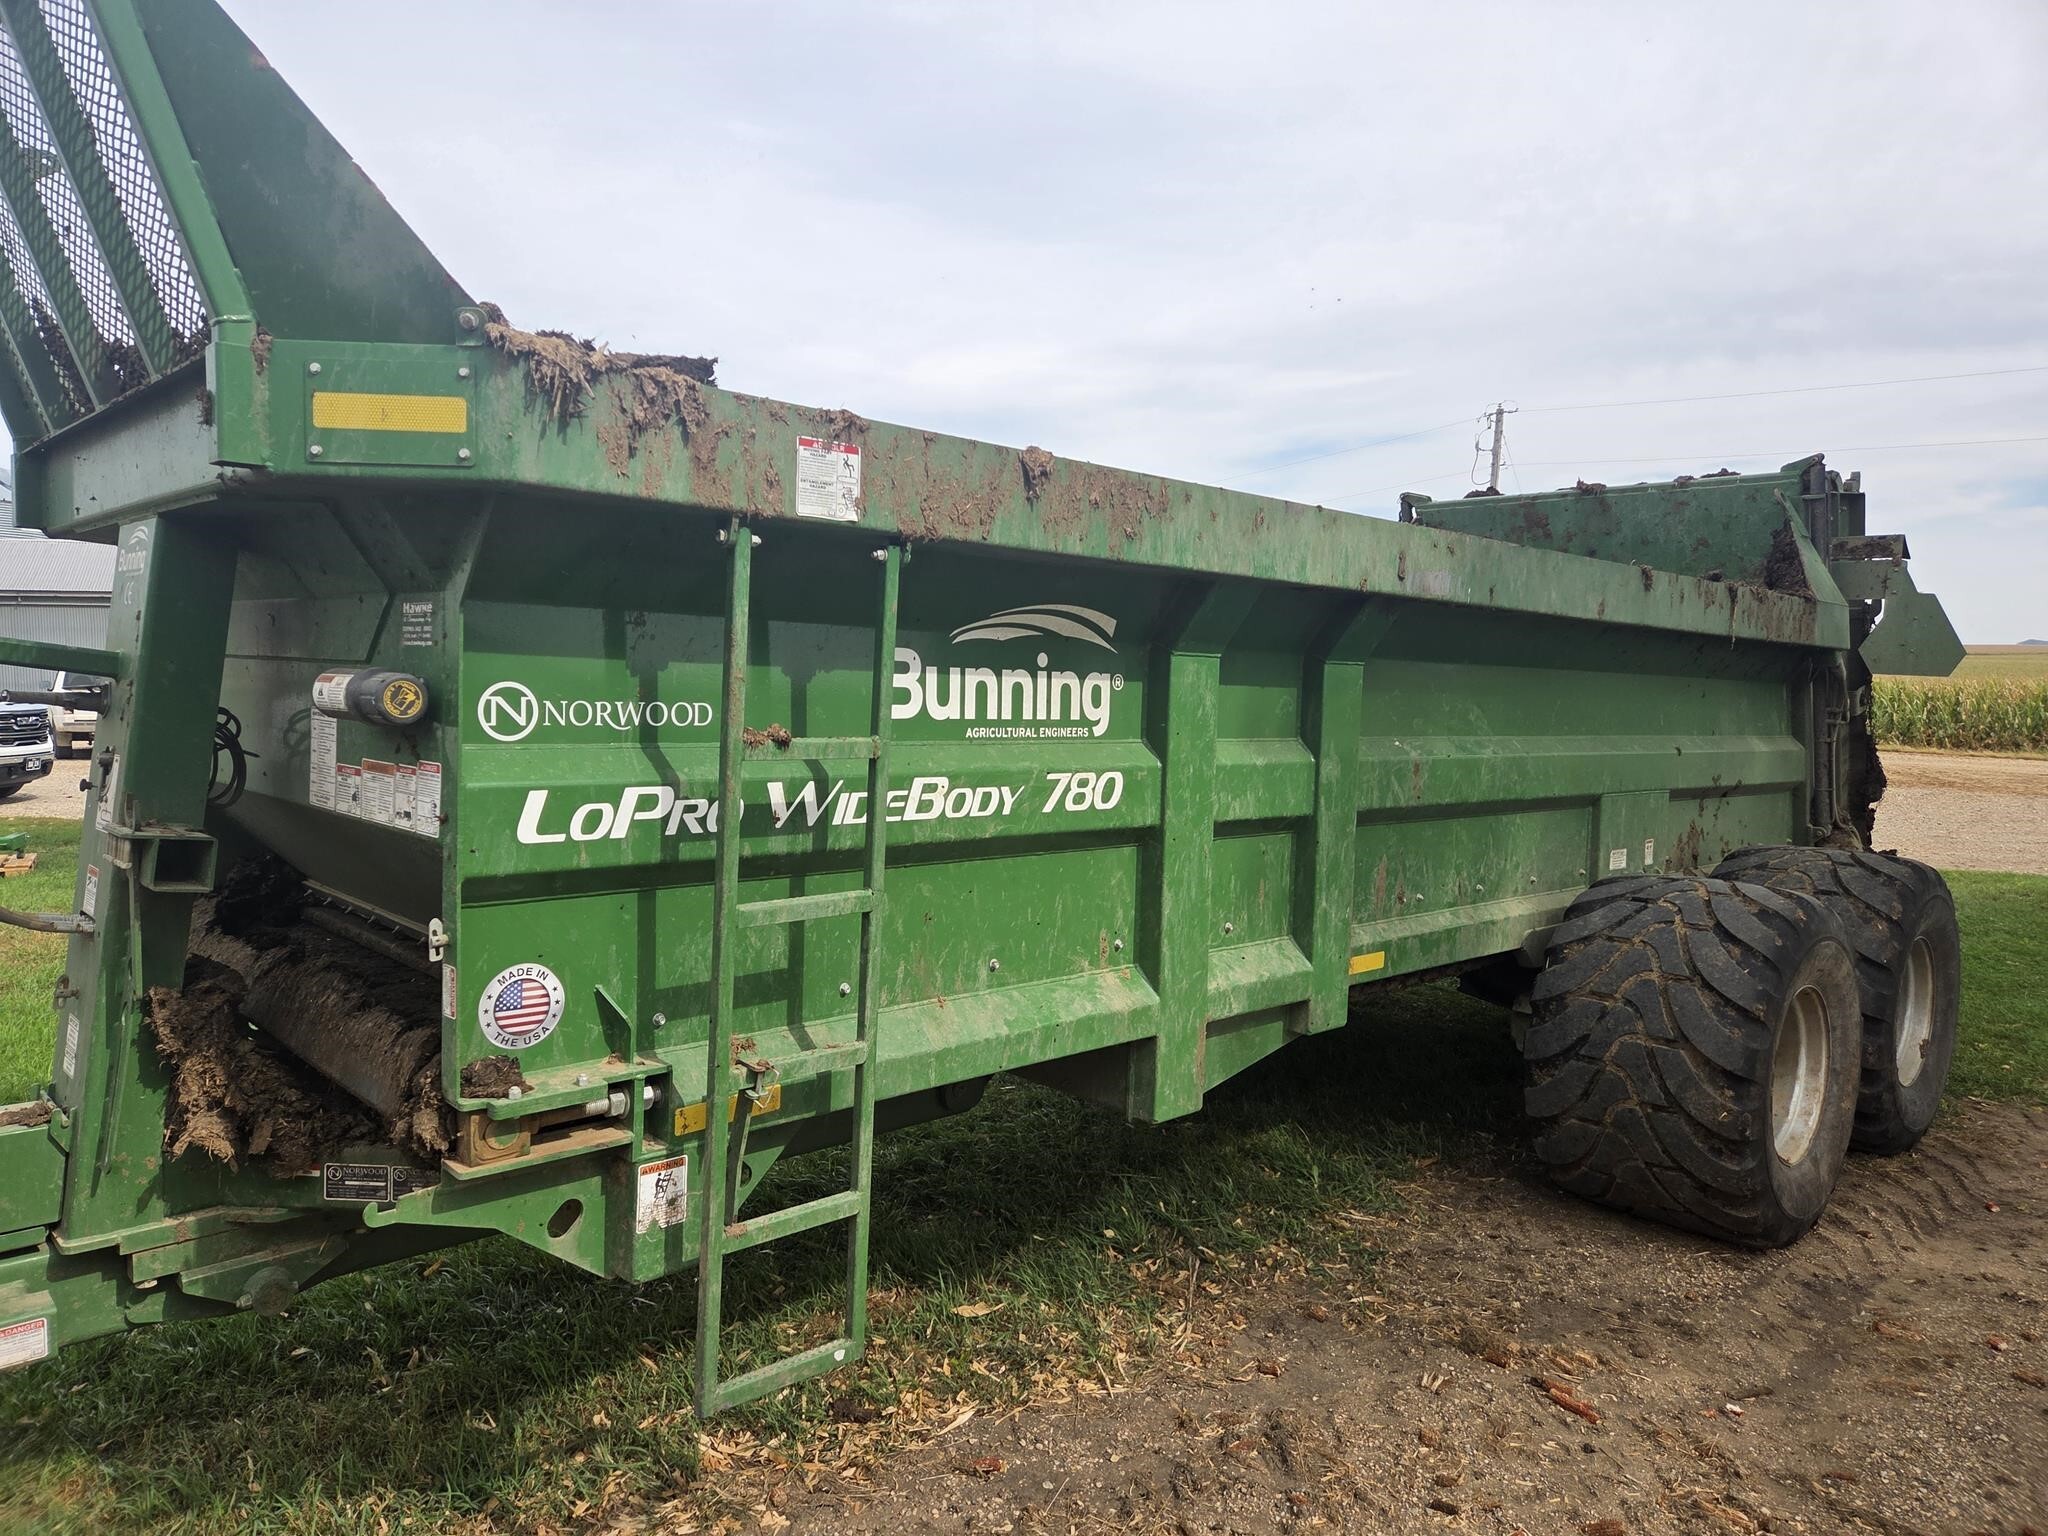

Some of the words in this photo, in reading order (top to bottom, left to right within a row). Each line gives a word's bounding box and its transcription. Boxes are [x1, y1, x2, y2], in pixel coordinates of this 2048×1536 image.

[543, 700, 713, 730] NORWOOD
[966, 727, 1037, 738] AGRICULTURAL
[1039, 727, 1089, 738] ENGINEERS
[1042, 771, 1124, 813] 780
[497, 967, 533, 987] MADE
[536, 969, 549, 981] IN
[493, 1031, 519, 1047] THE
[523, 1025, 550, 1045] USA
[343, 1167, 387, 1177] NORWOOD
[649, 1158, 684, 1172] WARNING
[5, 1321, 43, 1337] DANGER
